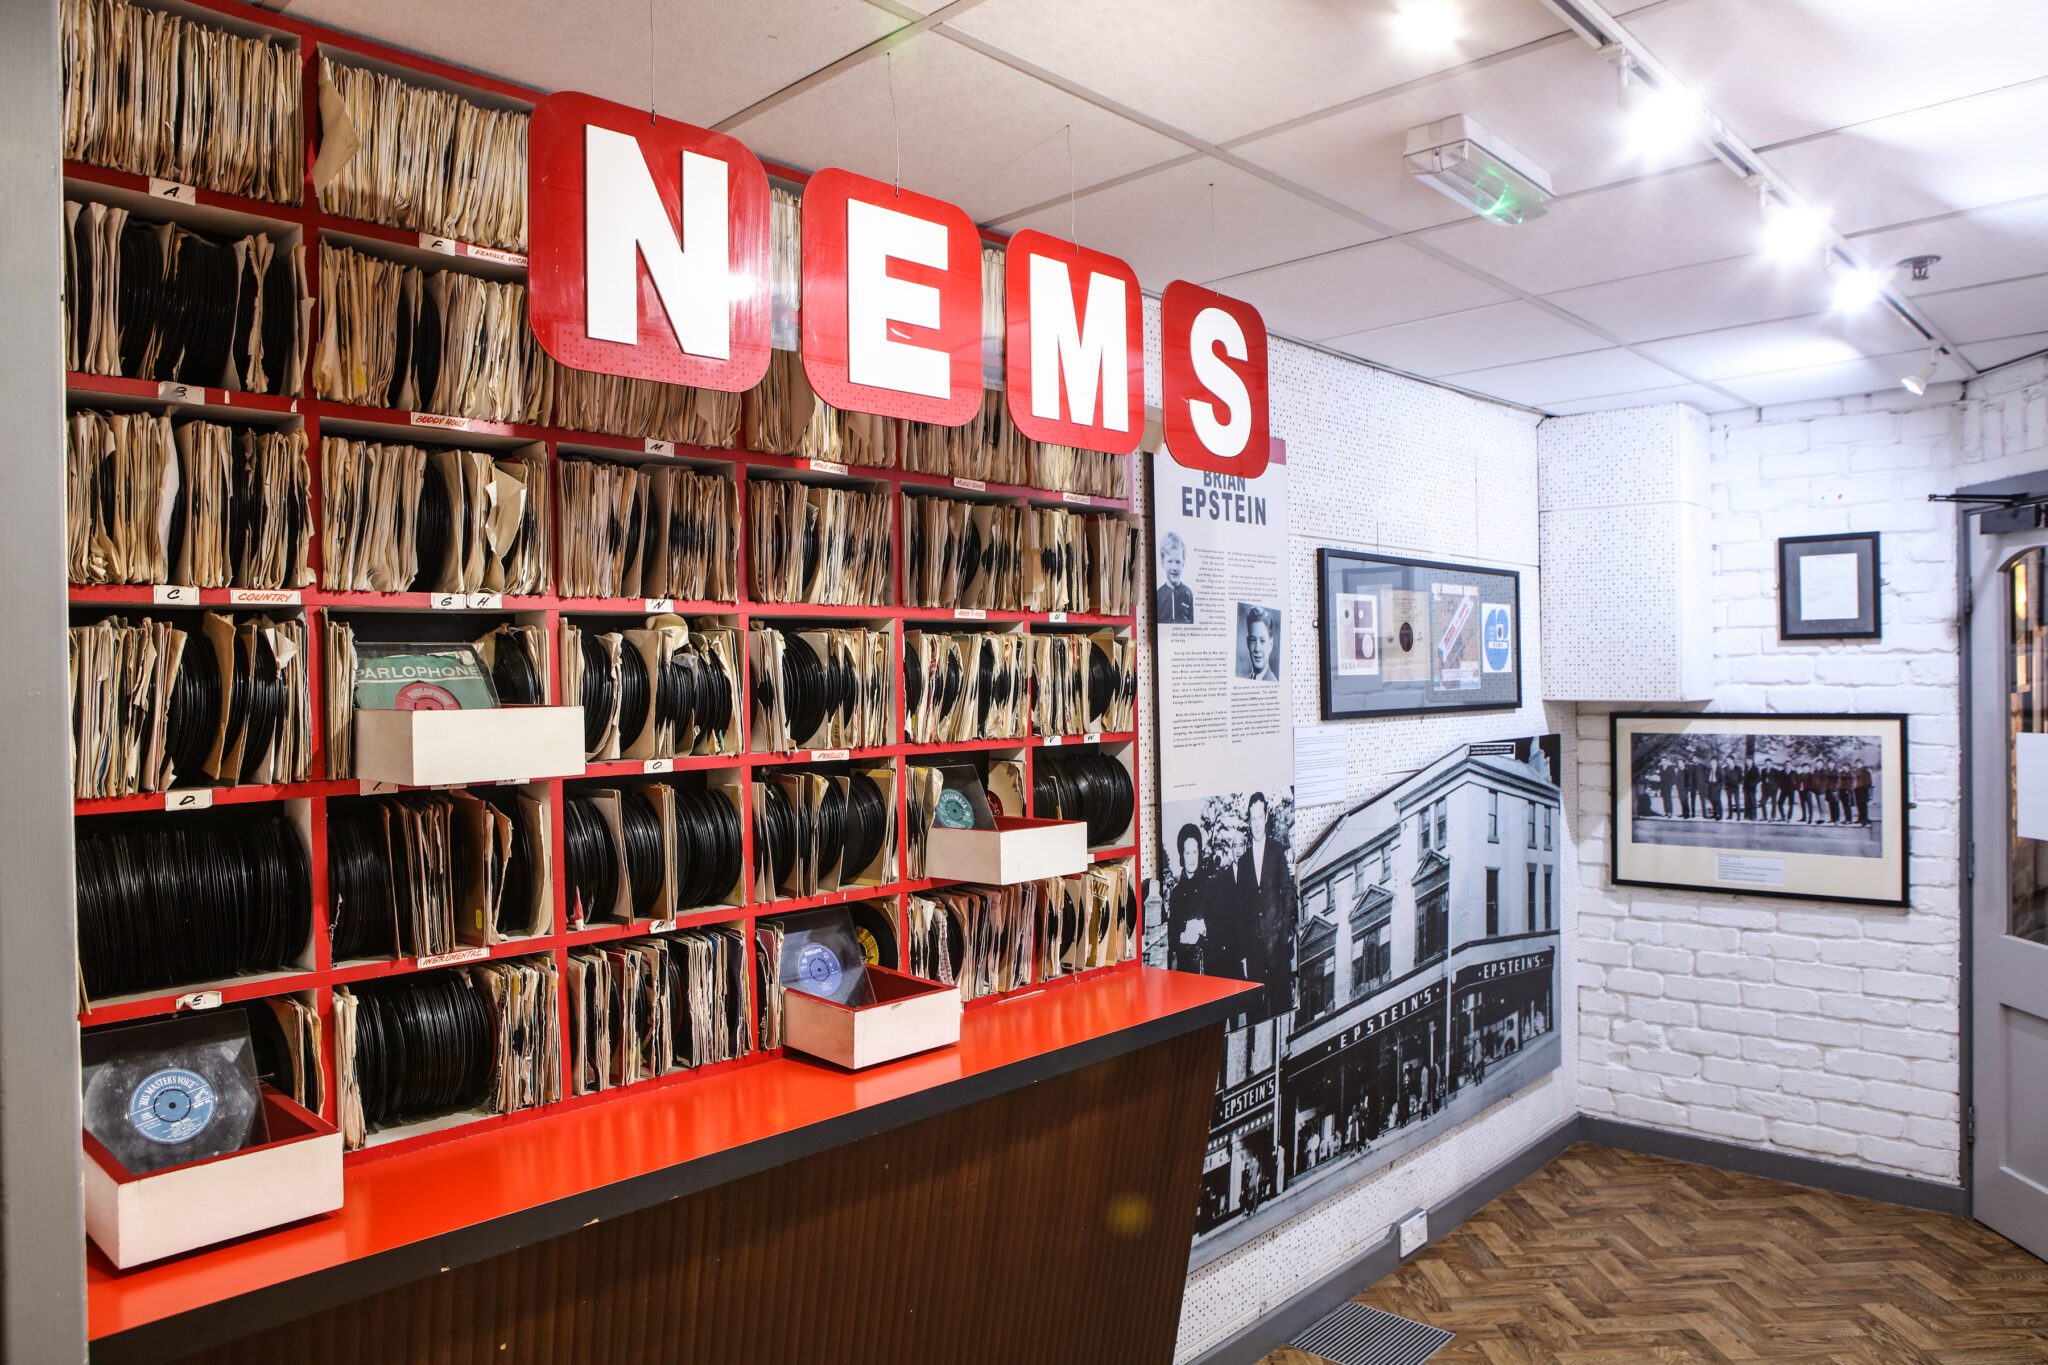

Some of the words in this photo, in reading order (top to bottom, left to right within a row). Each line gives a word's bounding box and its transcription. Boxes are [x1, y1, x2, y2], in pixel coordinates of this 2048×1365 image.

[474, 249, 505, 260] FEMALE
[508, 255, 528, 264] VOCA
[585, 124, 1251, 459] NEMS
[415, 415, 445, 425] BUDDY
[445, 418, 466, 428] HOLLY
[1204, 470, 1246, 492] BRIAN
[1182, 486, 1266, 525] EPSTEIN
[237, 592, 293, 602] COUNTRY
[407, 687, 453, 706] PARLOPHONE
[941, 793, 968, 809] COLUMBIA
[423, 949, 482, 966] INSTRUMENTAL
